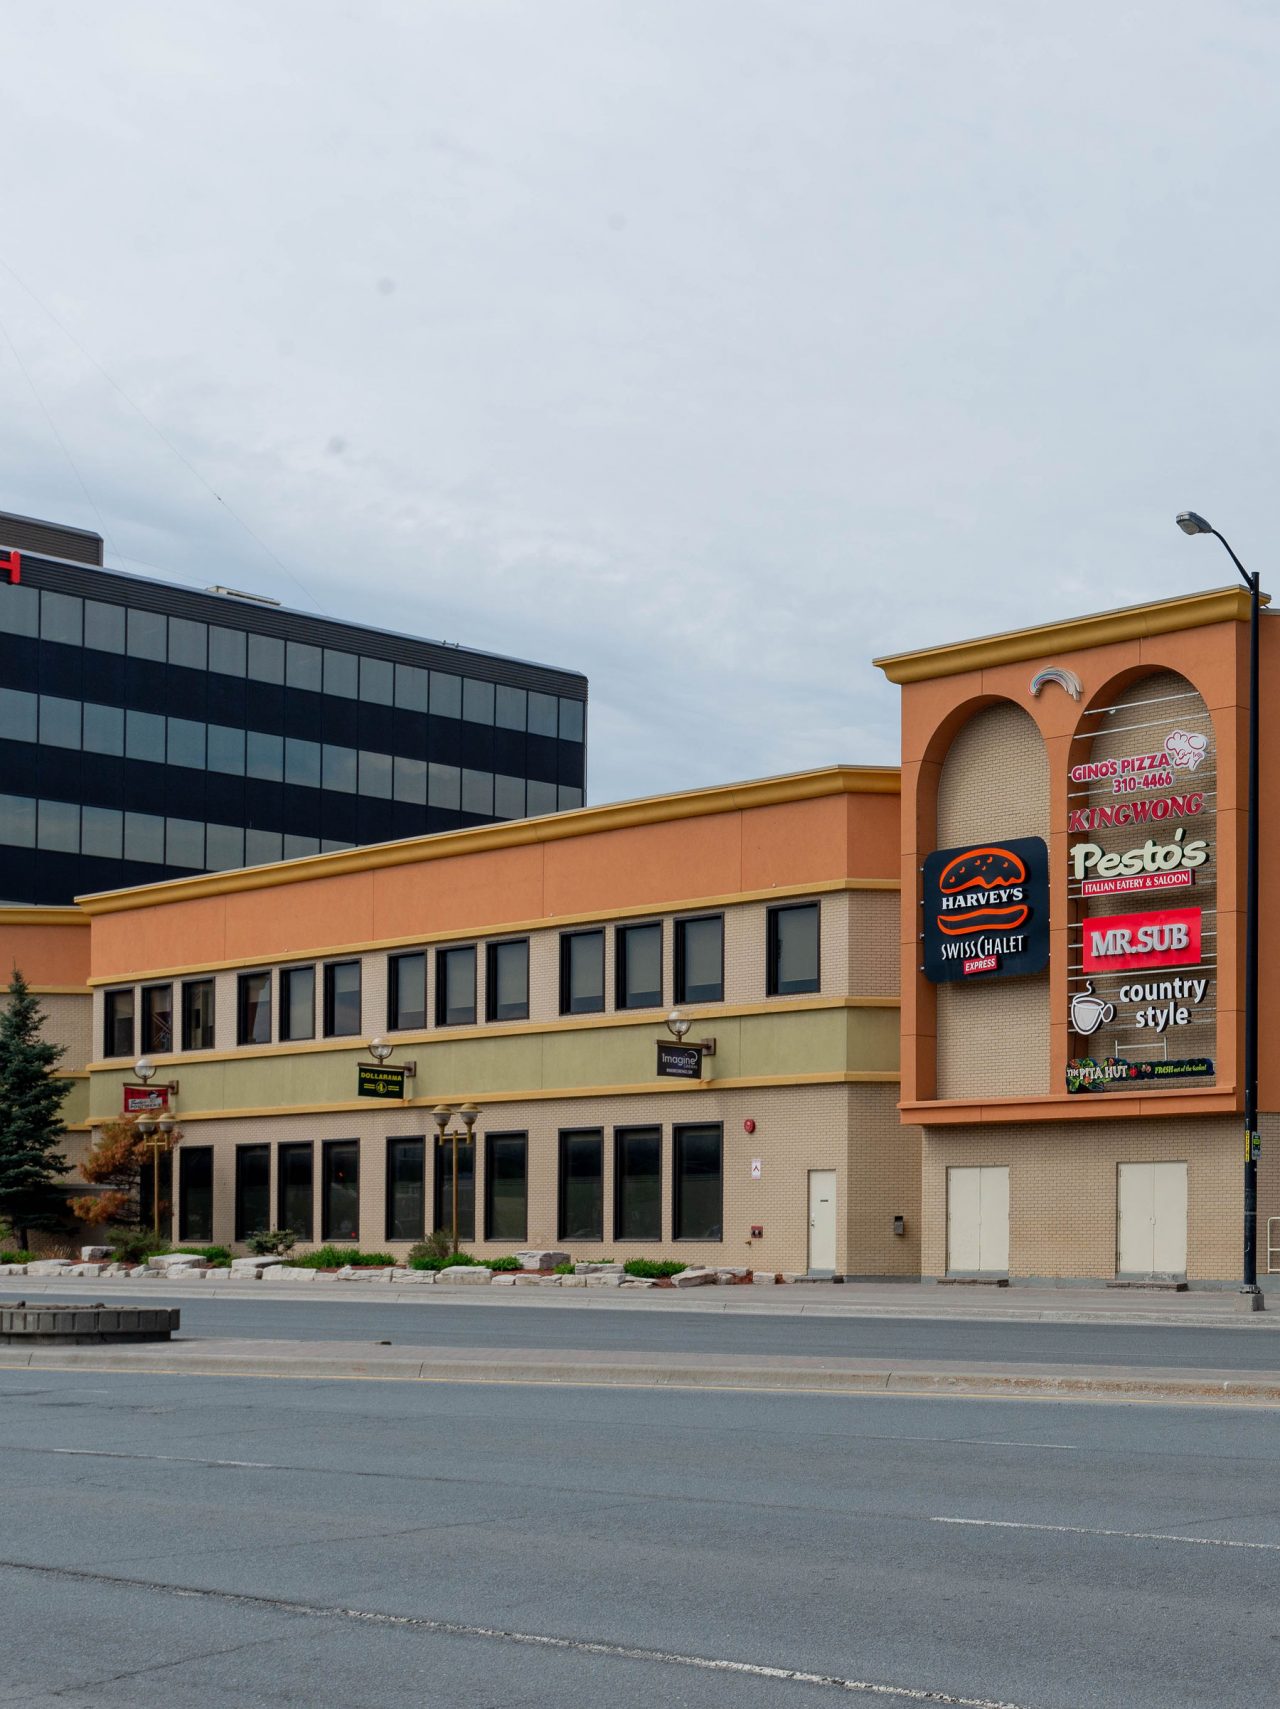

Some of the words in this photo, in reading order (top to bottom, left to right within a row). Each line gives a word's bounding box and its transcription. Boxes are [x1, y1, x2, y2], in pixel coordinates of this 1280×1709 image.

[1072, 759, 1118, 781] GINO'S
[1121, 753, 1171, 774] PIZZA
[1113, 771, 1173, 794] 310-4466
[1070, 828, 1207, 880] Pesto's
[1085, 881, 1115, 893] ITALIAN
[1117, 878, 1144, 890] EATERY
[1145, 876, 1152, 887] &
[1153, 873, 1188, 886] SALOON
[941, 887, 1023, 910] HARVEY'S
[965, 959, 996, 972] EXPRESS
[1120, 977, 1206, 1004] country
[1136, 1001, 1189, 1033] style
[361, 1072, 402, 1081] DOLLARAMA
[1080, 1066, 1104, 1079] PITA
[1104, 1065, 1128, 1078] HUT
[1154, 1065, 1173, 1074] FRESH
